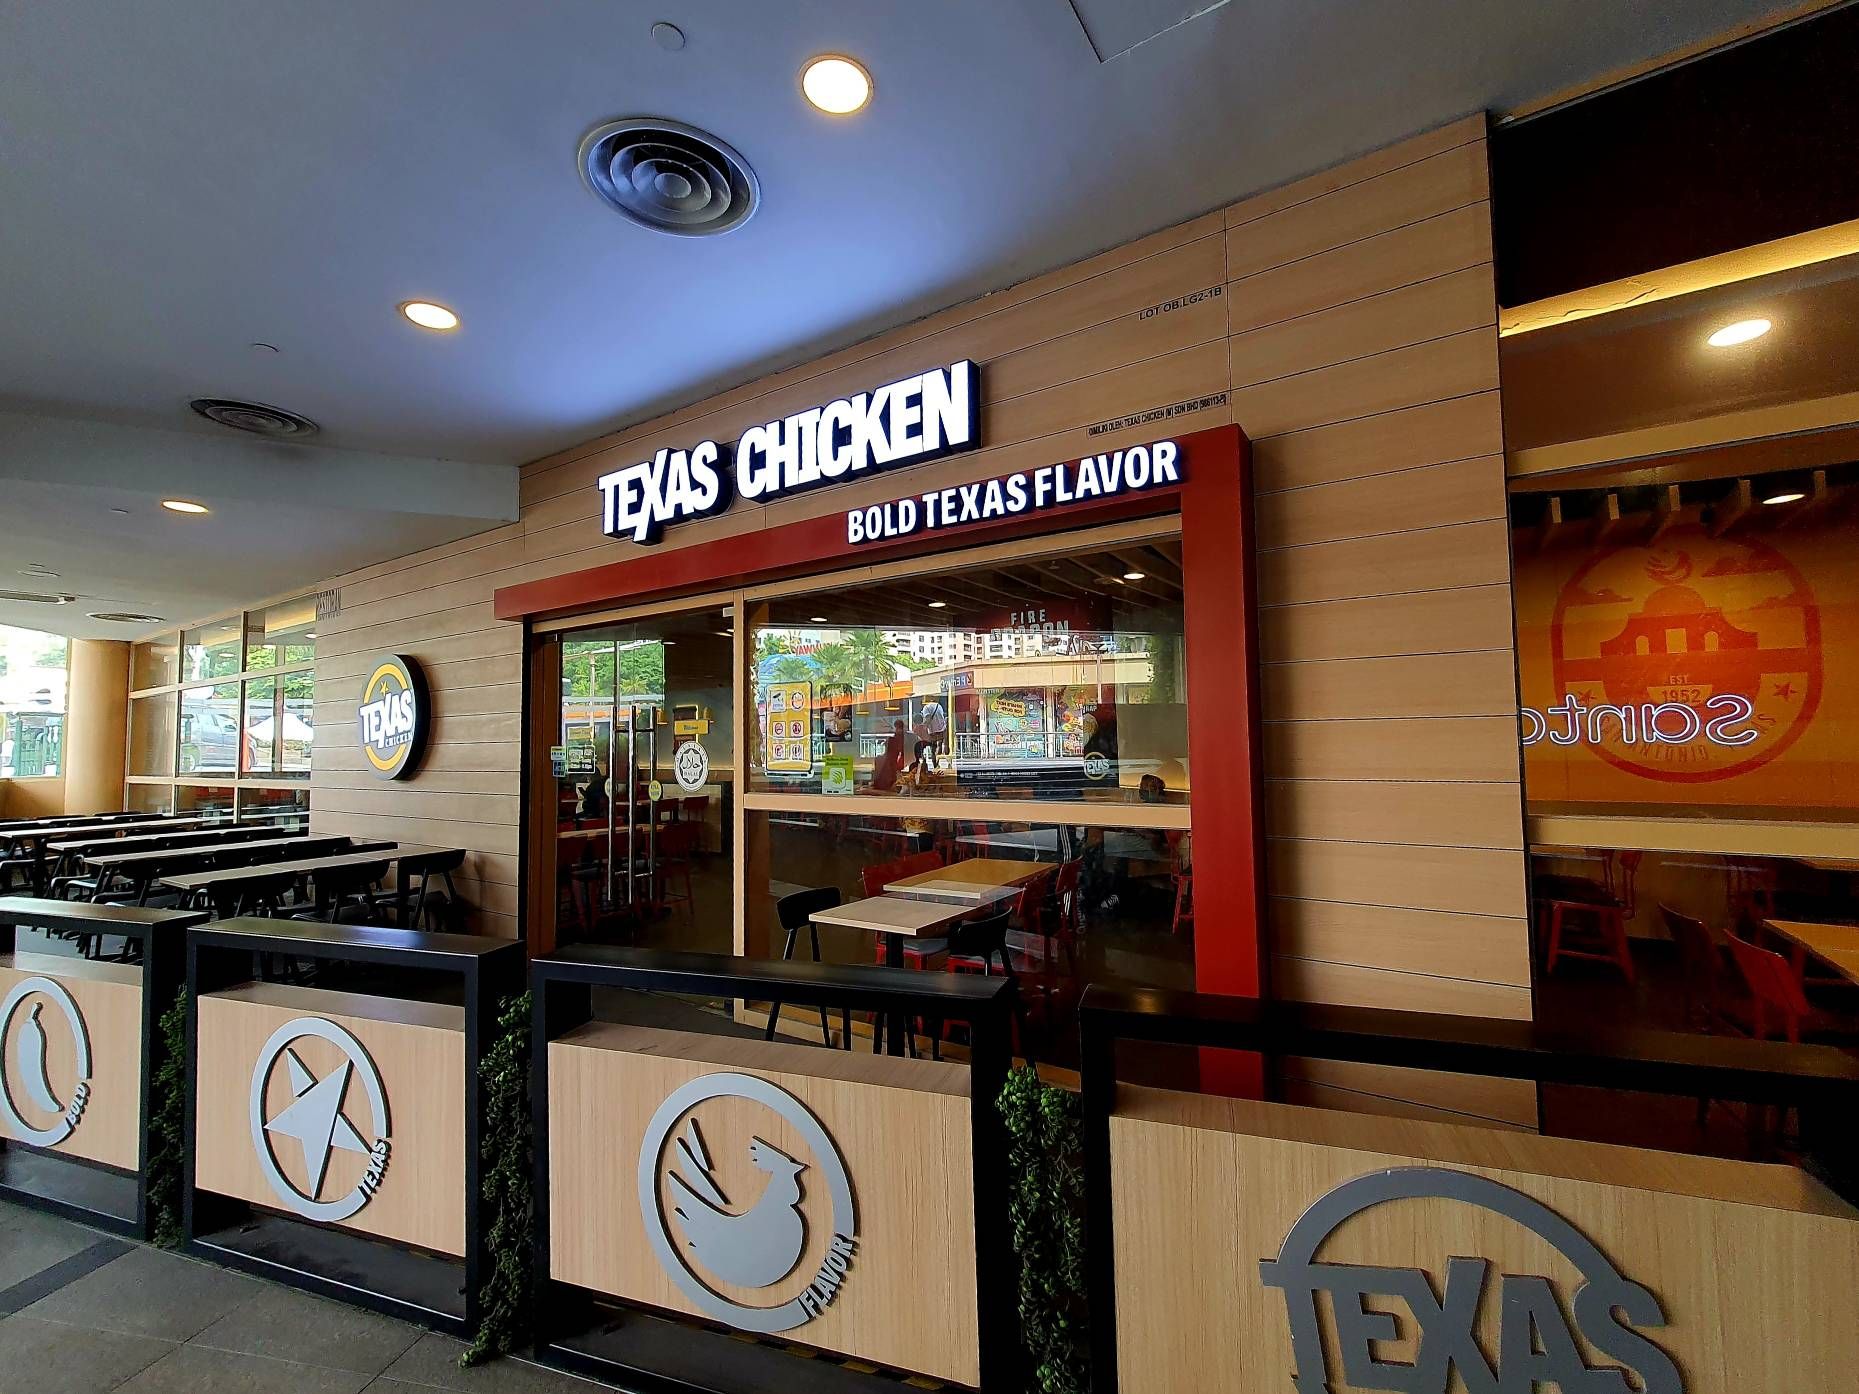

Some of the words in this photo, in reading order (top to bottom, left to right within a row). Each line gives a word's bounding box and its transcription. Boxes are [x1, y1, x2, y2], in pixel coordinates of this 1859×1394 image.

[1139, 307, 1160, 320] LOT
[1124, 416, 1141, 427] TEXAS
[1141, 410, 1165, 423] CHICKEN
[1174, 404, 1186, 415] SDN
[1187, 401, 1199, 412] BHD
[598, 440, 722, 542] TEXAS
[736, 359, 970, 500] CHICKEN
[847, 495, 917, 544] BOLD
[922, 474, 1028, 528] TEXAS
[1034, 441, 1179, 508] FLAVOR
[1010, 609, 1047, 625] FIRE
[1662, 688, 1702, 704] 1952
[1669, 674, 1689, 685] EST
[359, 688, 414, 749] TEXAS
[65, 1083, 86, 1126] BOLD
[358, 1138, 387, 1195] TEXAS
[799, 1235, 853, 1318] FLAVOR
[1259, 1255, 1688, 1394] TEXAS
